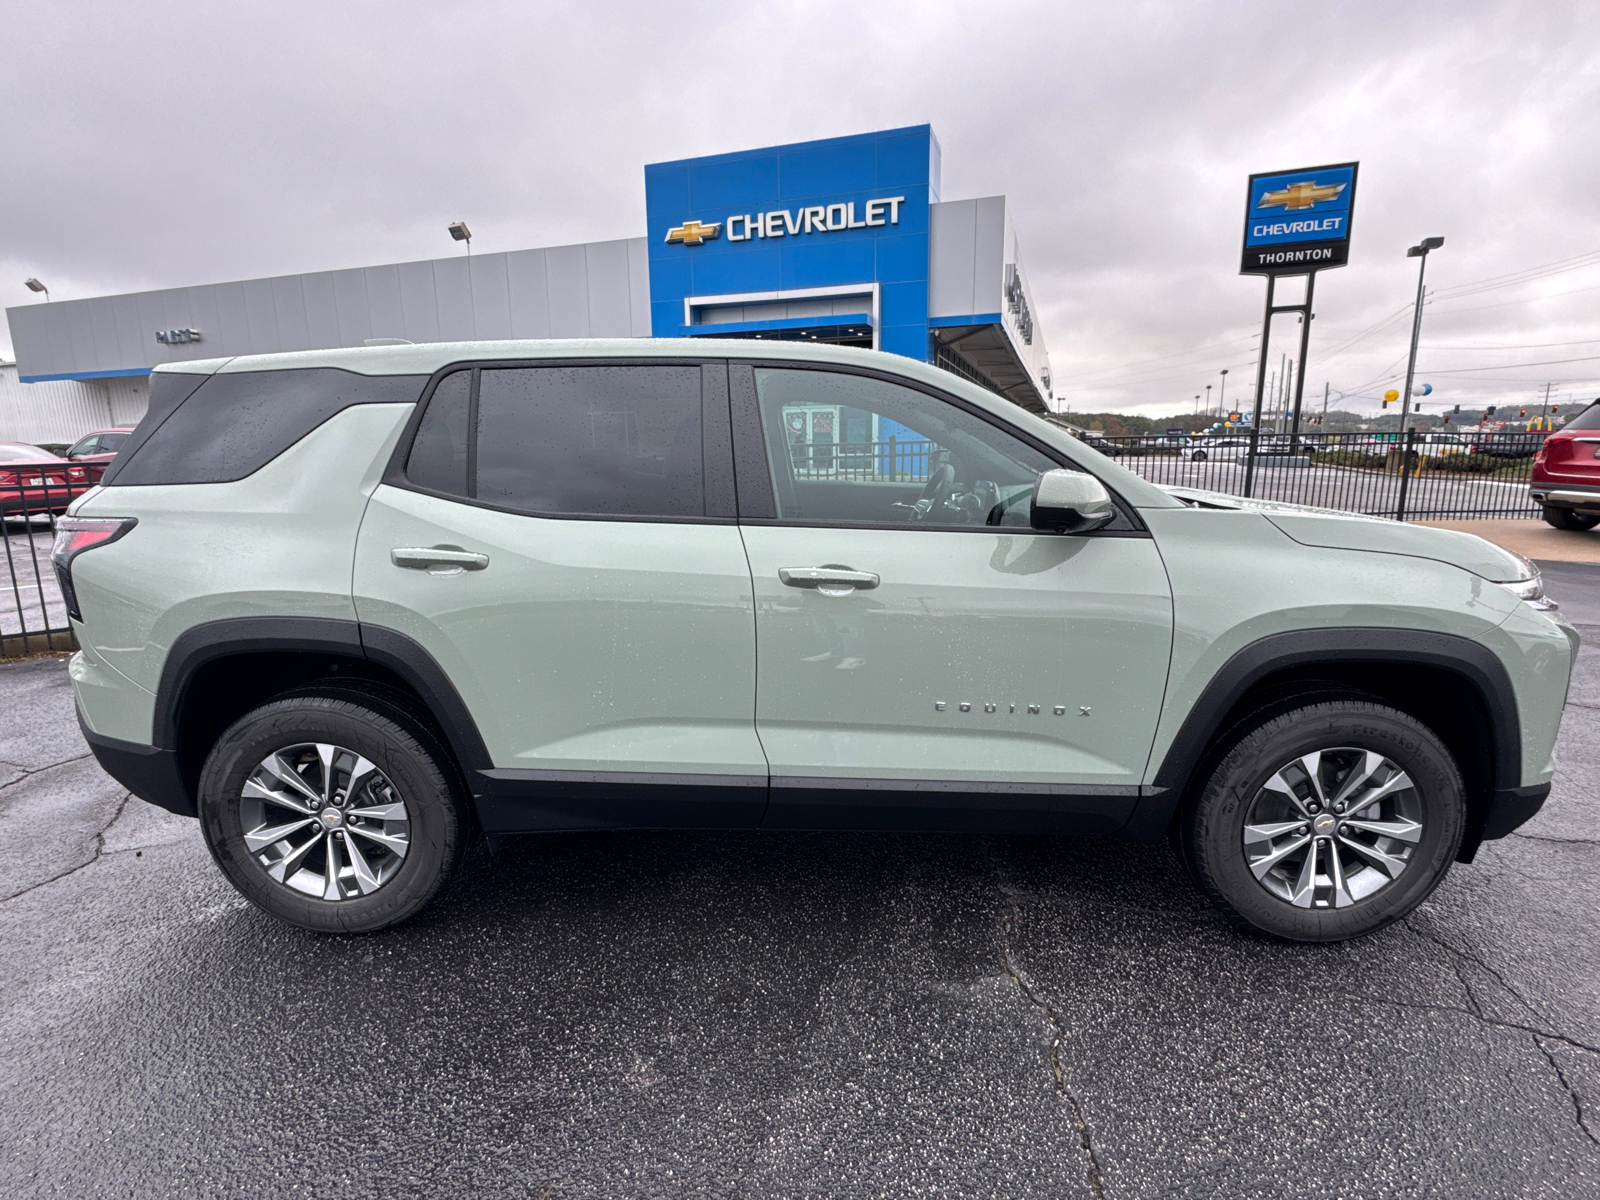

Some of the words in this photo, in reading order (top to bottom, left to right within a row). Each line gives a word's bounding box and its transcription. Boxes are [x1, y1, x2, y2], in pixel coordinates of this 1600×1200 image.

[727, 195, 905, 242] CHEVROLET
[1253, 217, 1343, 237] CHEVROLET
[1258, 248, 1332, 264] THORNTON
[156, 328, 199, 343] PARTS
[935, 701, 1091, 716] EQUINOX
[1350, 722, 1433, 767] Firestone
